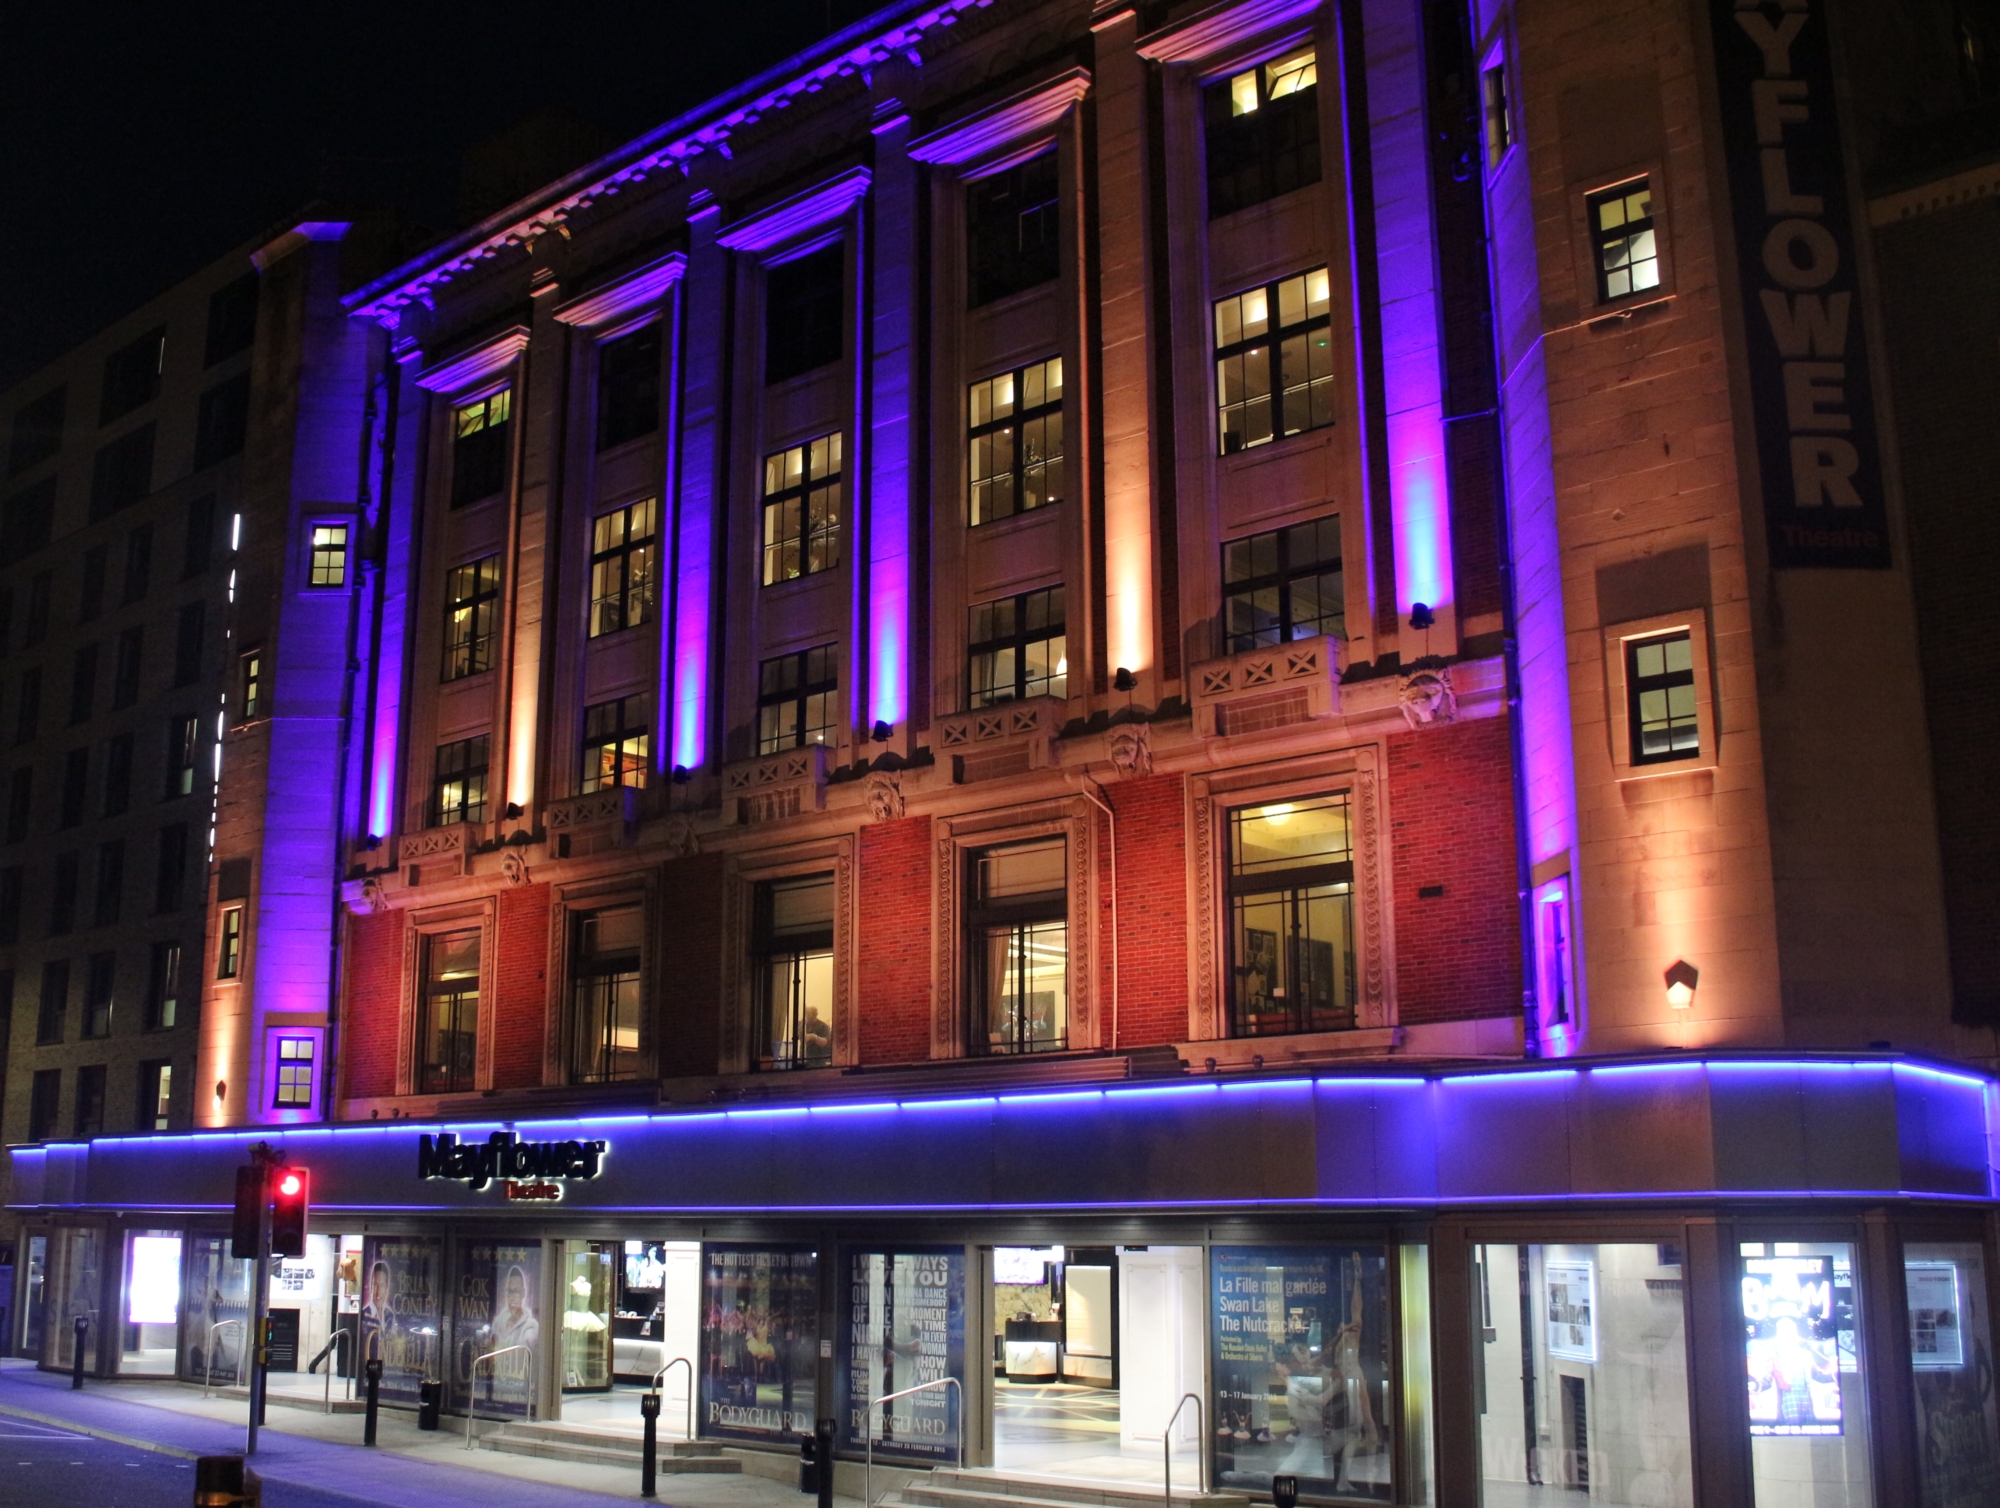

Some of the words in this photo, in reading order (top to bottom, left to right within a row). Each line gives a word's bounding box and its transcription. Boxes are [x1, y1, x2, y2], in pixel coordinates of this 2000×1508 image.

[1733, 0, 1864, 508] YFLOWER
[1780, 525, 1879, 547] Theatre
[418, 1131, 607, 1190] Mayflower
[503, 1180, 562, 1200] Theatre
[724, 1254, 755, 1267] HOTTEST
[756, 1254, 779, 1268] TICKET
[781, 1256, 789, 1268] IN
[398, 1271, 434, 1296] BRIAN
[910, 1270, 948, 1286] YOU
[1219, 1277, 1232, 1293] La
[1235, 1277, 1259, 1294] Fille
[1261, 1278, 1284, 1294] mal
[1285, 1275, 1327, 1297] gardée
[852, 1286, 892, 1305] QUN
[924, 1288, 948, 1299] DANCE
[393, 1293, 438, 1316] CONLEY
[459, 1296, 490, 1319] WAN
[912, 1299, 947, 1307] SOMEBODY
[1220, 1296, 1250, 1312] Swan
[1252, 1298, 1279, 1313] Lake
[852, 1305, 868, 1322] OF
[910, 1308, 947, 1320] MOMENT
[924, 1321, 947, 1331] TIME
[1220, 1315, 1240, 1332] The
[1243, 1316, 1308, 1334] Nutcracker
[931, 1332, 947, 1342] EVERY
[856, 1346, 879, 1360] HAVE
[920, 1342, 947, 1355] WOMAN
[920, 1356, 947, 1369] HOW
[919, 1368, 944, 1381] WILL
[1220, 1390, 1228, 1398] 13
[1233, 1391, 1240, 1399] 17
[1241, 1391, 1262, 1401] January
[910, 1399, 946, 1409] TONIGHT
[709, 1402, 807, 1431] BODYGUARD
[850, 1409, 946, 1435] BODYGUARD
[881, 1440, 903, 1449] SATURDAY
[911, 1443, 933, 1452] FEBRUARY
